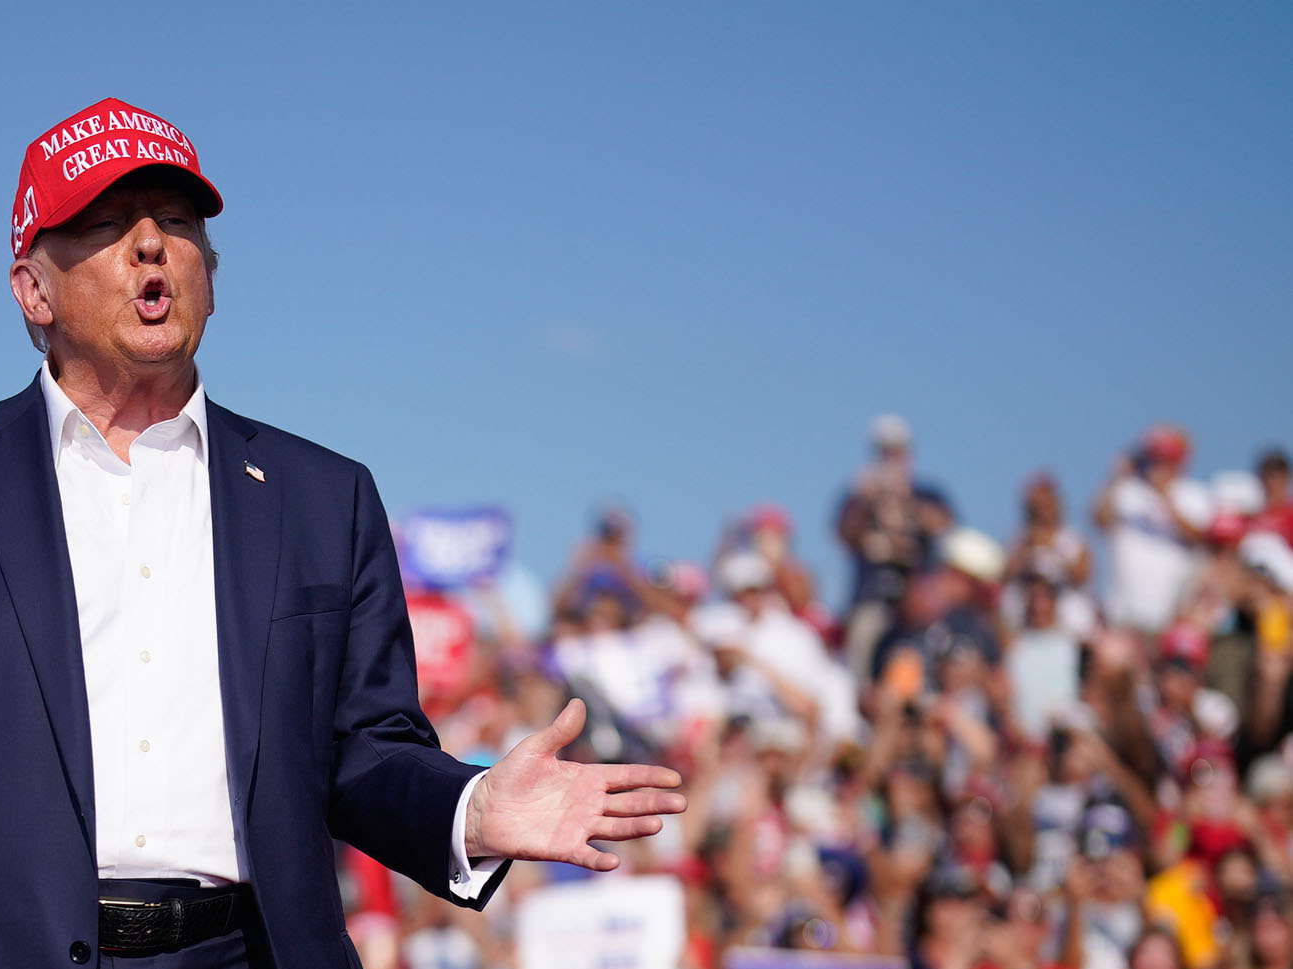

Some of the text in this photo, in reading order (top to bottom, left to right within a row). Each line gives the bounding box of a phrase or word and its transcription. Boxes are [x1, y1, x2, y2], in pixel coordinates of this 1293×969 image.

[39, 110, 195, 161] MAKE AMERICA
[62, 138, 132, 182] GREAT
